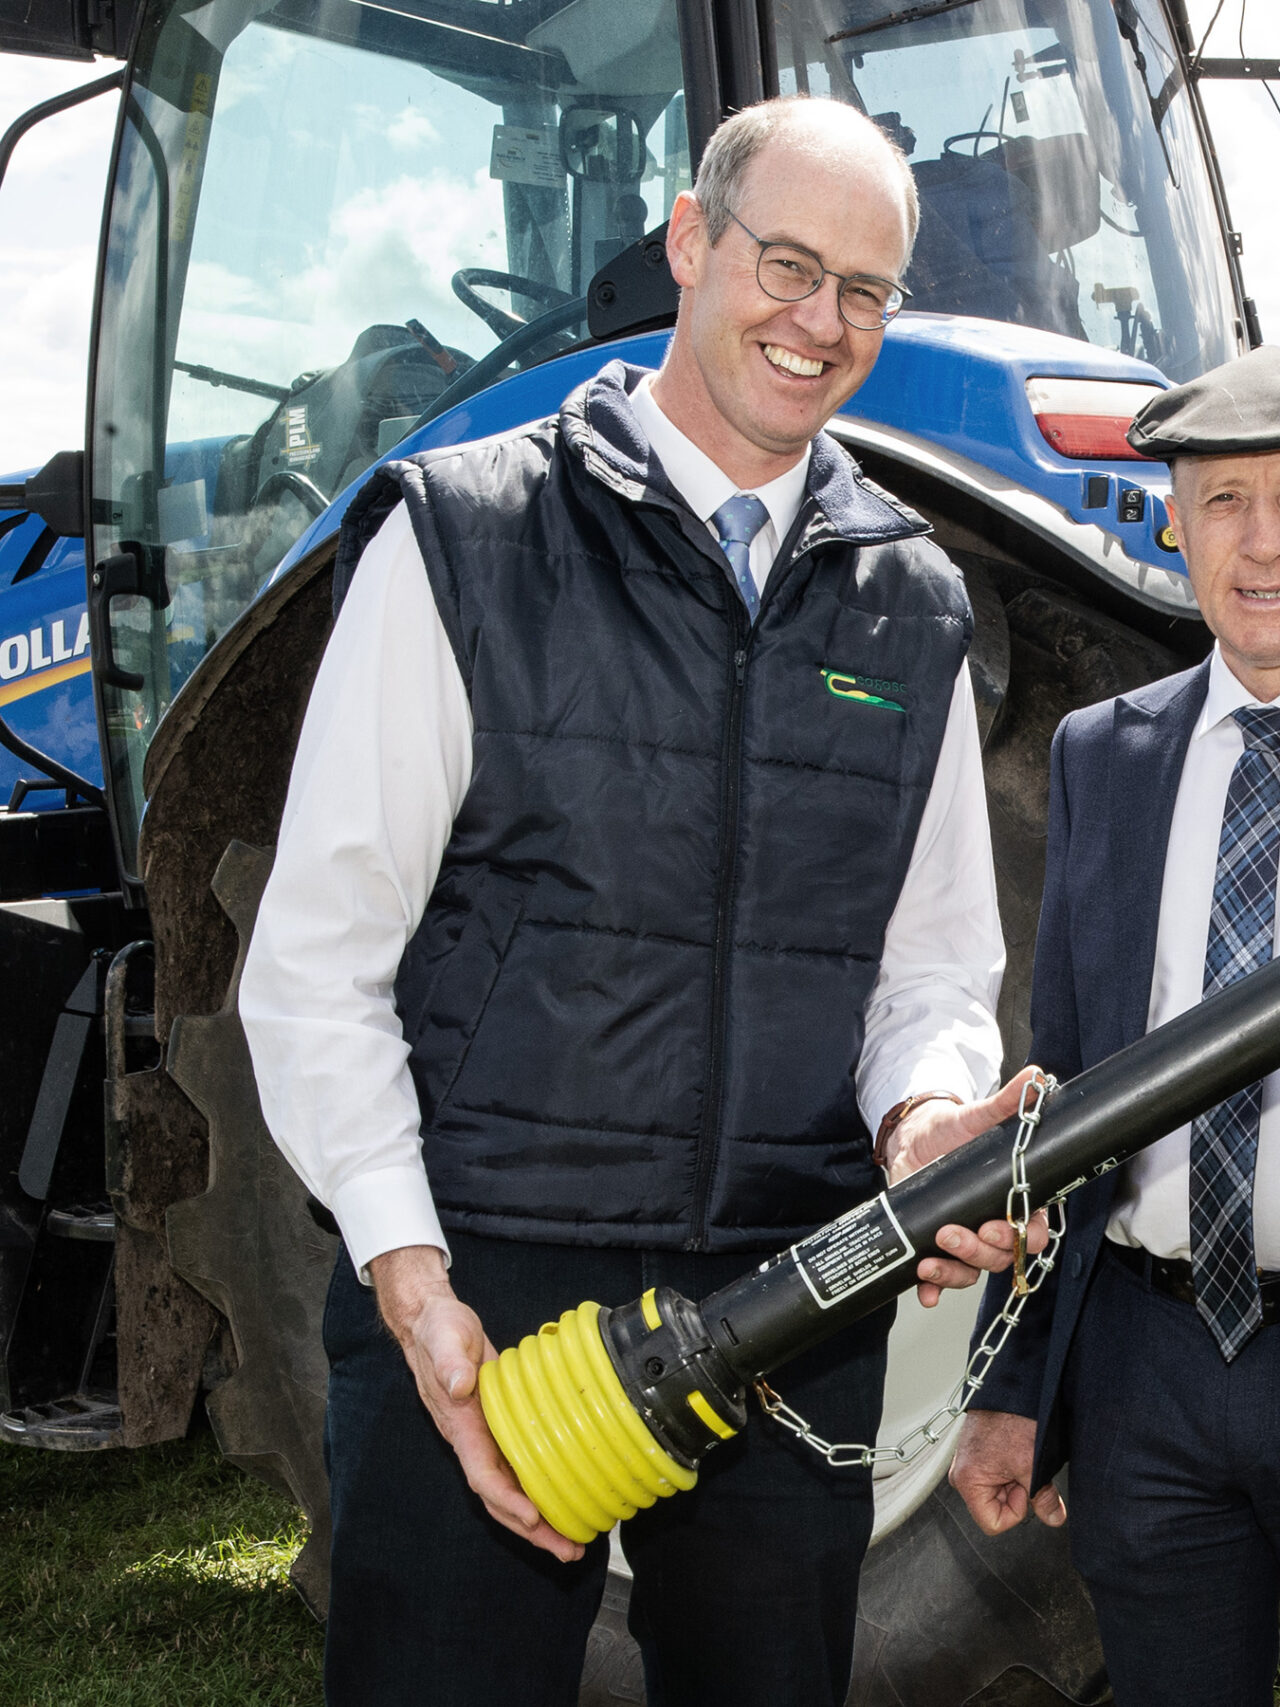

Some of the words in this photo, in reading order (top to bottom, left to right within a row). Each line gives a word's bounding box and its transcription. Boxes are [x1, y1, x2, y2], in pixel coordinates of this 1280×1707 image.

[289, 408, 305, 447] PLM
[807, 1255, 816, 1263] DO
[815, 1249, 826, 1259] NOT
[825, 1236, 848, 1252] OPERATE
[847, 1223, 870, 1239] WITHOUT
[867, 1230, 883, 1242] PLACE
[814, 1258, 824, 1267] ALL
[848, 1231, 870, 1247] TRACTOR
[869, 1225, 880, 1234] AND
[872, 1254, 885, 1264] THAT
[884, 1246, 898, 1257] TURN
[853, 1255, 868, 1266] BOTH
[866, 1247, 880, 1258] ENDS
[830, 1282, 848, 1296] FREELY
